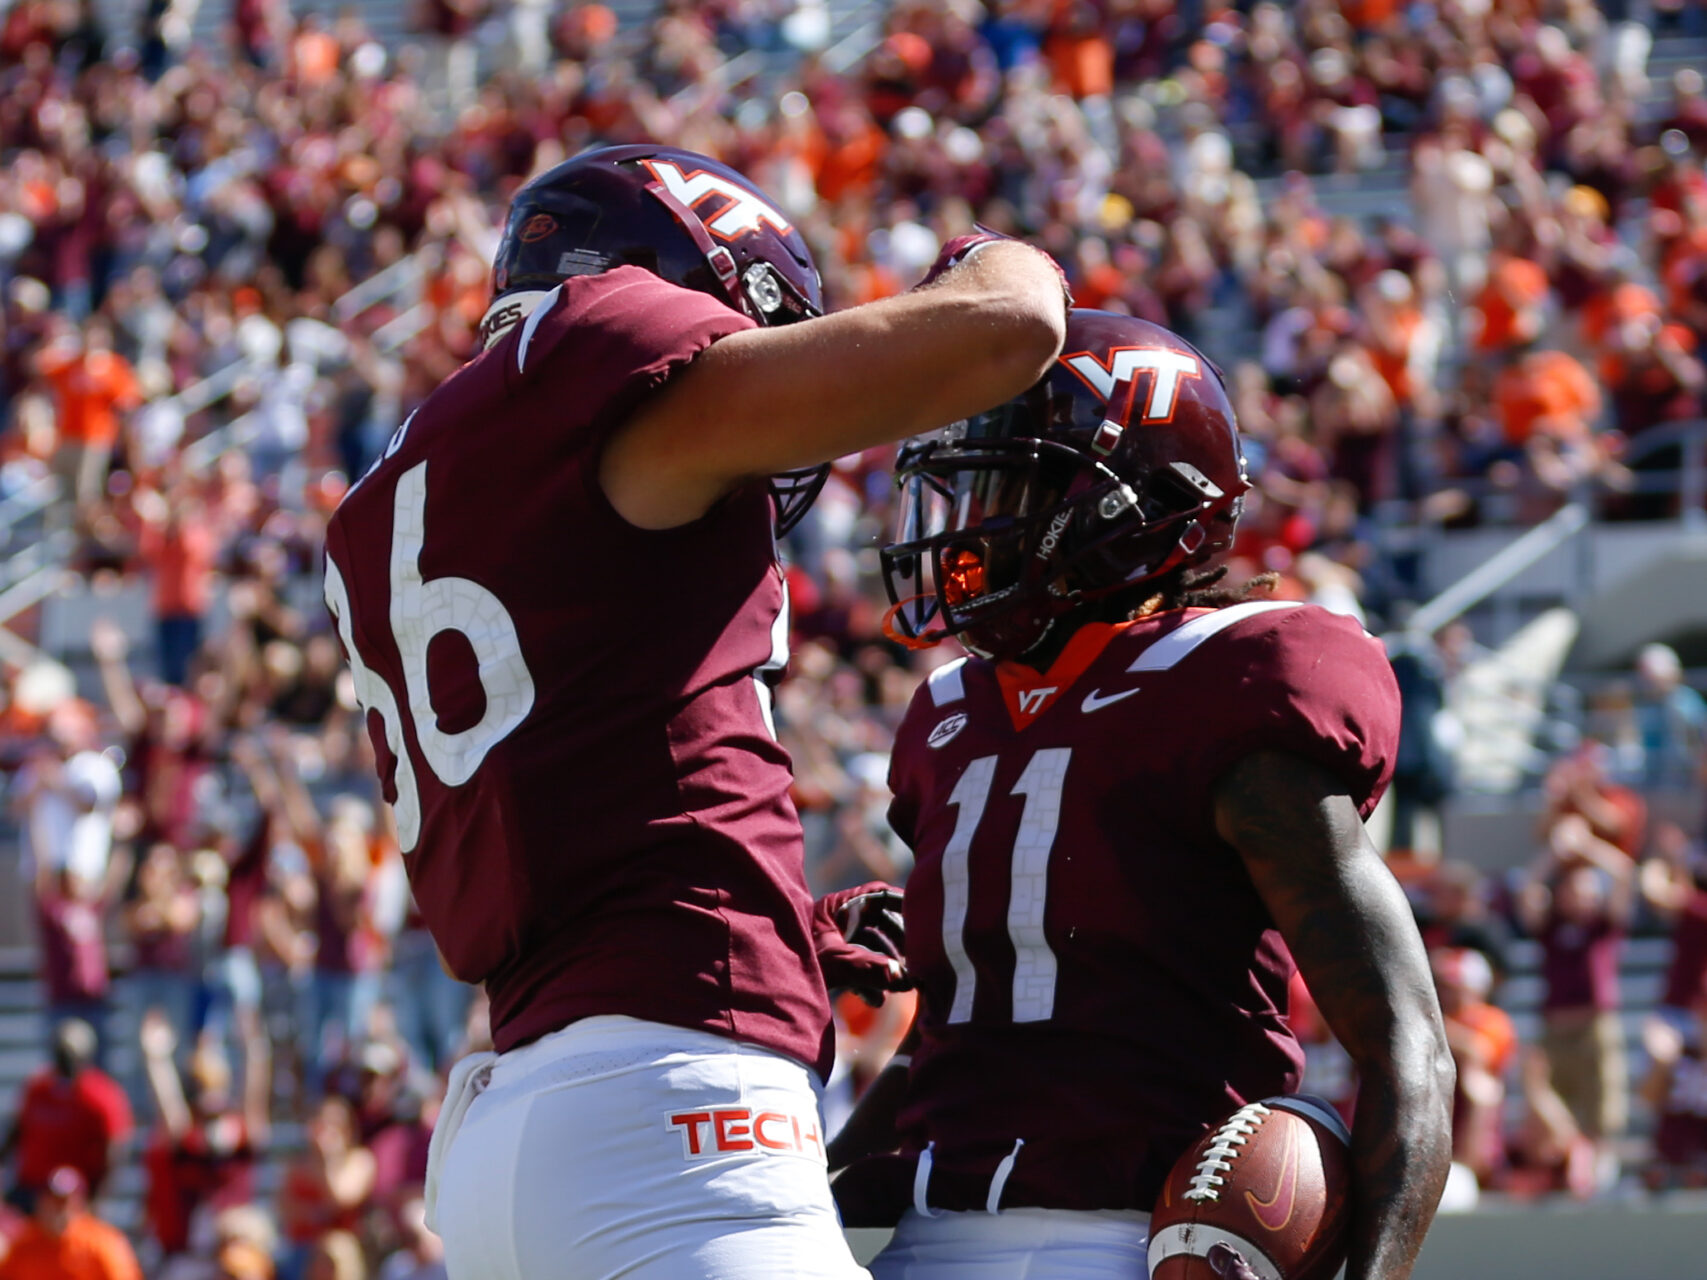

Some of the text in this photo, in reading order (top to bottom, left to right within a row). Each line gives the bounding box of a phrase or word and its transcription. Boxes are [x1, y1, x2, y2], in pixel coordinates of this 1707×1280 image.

[1058, 346, 1202, 430] VT
[1035, 505, 1075, 560] HOKIE
[1018, 685, 1059, 715] VT
[930, 715, 966, 741] ACC
[941, 747, 1072, 1025] 11
